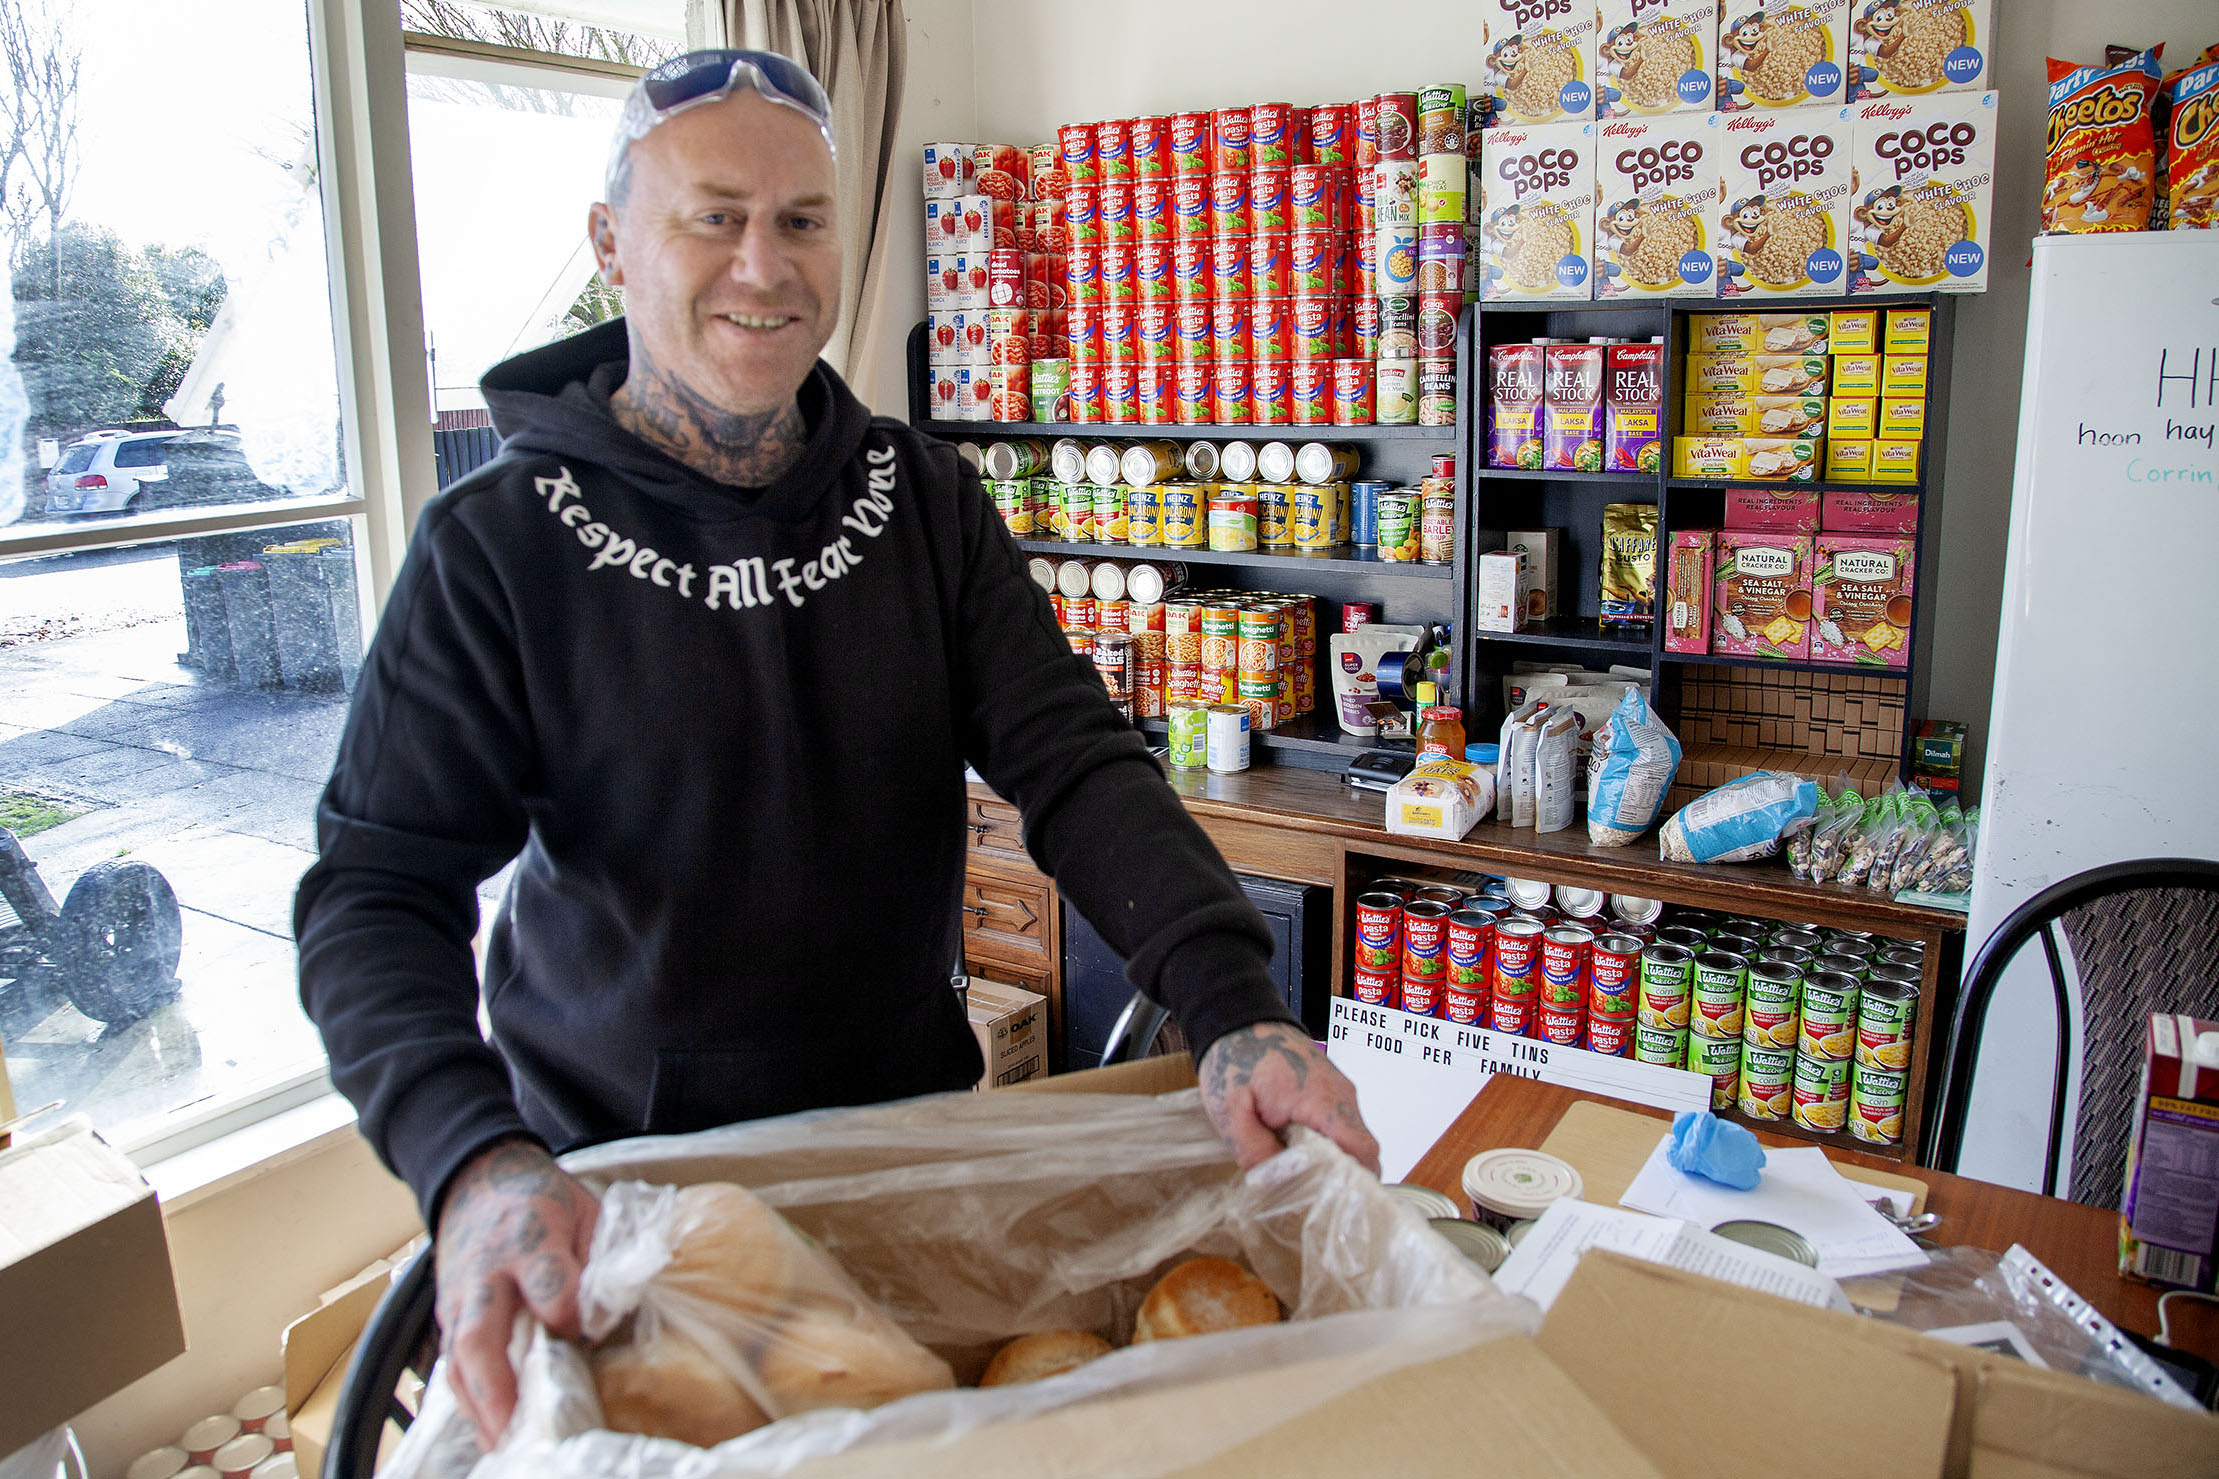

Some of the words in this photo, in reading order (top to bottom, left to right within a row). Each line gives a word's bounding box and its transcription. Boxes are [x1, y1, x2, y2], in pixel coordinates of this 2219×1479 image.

[1776, 9, 1811, 27] WHITE
[1811, 0, 1845, 14] CHOC
[1648, 20, 1681, 37] WHITE
[1682, 6, 1713, 24] CHOC
[1531, 32, 1563, 49] WHITE
[1562, 20, 1593, 37] CHOC
[1666, 24, 1702, 43] FLAVOUR
[1947, 59, 1980, 71] NEW
[1808, 73, 1838, 85] NEW
[1680, 80, 1708, 92] NEW
[1422, 91, 1450, 101] Wattie's
[1562, 92, 1589, 103] NEW
[1860, 103, 1912, 120] Kellogg's
[1253, 119, 1277, 132] pasta
[1727, 118, 1775, 134] Kellogg's
[2047, 86, 2144, 155] Cheetos
[1602, 123, 1649, 138] Kellogg's
[1487, 132, 1528, 147] Kellogg's
[1875, 122, 1976, 159] COCO
[1616, 140, 1703, 174] COCO
[1740, 134, 1834, 170] COCO
[1499, 148, 1579, 180] COCO
[1894, 148, 1965, 181] pops
[1632, 164, 1694, 194] pops
[1758, 159, 1824, 191] pops
[1514, 171, 1571, 200] pops
[1913, 184, 1952, 203] WHITE
[1954, 174, 1989, 192] CHOC
[1650, 198, 1683, 215] WHITE
[1685, 188, 1717, 204] CHOC
[1776, 194, 1812, 212] WHITE
[1814, 184, 1847, 202] CHOC
[1934, 192, 1976, 211] FLAVOUR
[1530, 204, 1561, 221] WHITE
[1562, 194, 1592, 210] CHOC
[1667, 204, 1705, 222] FLAVOUR
[1795, 201, 1835, 220] FLAVOUR
[1546, 211, 1580, 227] FLAVOUR
[1810, 260, 1840, 271] NEW
[1949, 253, 1981, 265] NEW
[1558, 265, 1585, 276] NEW
[1681, 261, 1710, 272] NEW
[1497, 350, 1534, 361] Campbell's
[1554, 349, 1593, 361] Campbell's
[1616, 349, 1655, 361] Campbell's
[1336, 377, 1359, 388] pasta
[1497, 371, 1535, 388] REAL
[1554, 371, 1593, 388] REAL
[1616, 371, 1658, 388] REAL
[1496, 388, 1535, 400] STOCK
[1553, 388, 1593, 401] STOCK
[1615, 388, 1658, 401] STOCK
[1503, 417, 1527, 425] LAKSA
[1560, 418, 1585, 426] LAKSA
[2078, 422, 2142, 446] hoon
[2166, 418, 2215, 449] hay
[1129, 493, 1152, 502] HEINZ
[1166, 494, 1190, 503] HEINZ
[1259, 493, 1282, 502] HEINZ
[1425, 500, 1454, 509] Wattie's
[534, 465, 697, 598] Respect
[704, 556, 775, 610] All
[771, 534, 864, 608] Fear
[842, 444, 896, 538] None
[1423, 526, 1454, 534] BARLEY
[1610, 536, 1656, 553] L'AFFARE
[1617, 554, 1650, 562] GUSTO
[1741, 555, 1788, 564] NATURAL
[1840, 558, 1889, 568] NATURAL
[1839, 566, 1873, 574] CRACKER
[1742, 579, 1760, 588] SEA
[1761, 580, 1783, 589] SALT
[1841, 584, 1859, 593] SEA
[1861, 585, 1883, 593] SALT
[1745, 587, 1786, 596] VINEGAR
[1844, 592, 1887, 601] VINEGAR
[1202, 622, 1234, 631] Spaghetti
[1241, 625, 1274, 634] Spaghetti
[1425, 744, 1448, 753] Craig's
[1925, 749, 1951, 759] Dilmah
[1361, 910, 1390, 924] Wattie's
[1363, 924, 1389, 935] pasta
[1408, 919, 1439, 932] Wattie's
[1411, 932, 1437, 943] pasta
[1450, 928, 1477, 940] Wattie's
[1450, 941, 1476, 952] pasta
[1499, 937, 1529, 951] Wattie's
[1500, 952, 1527, 963] pasta
[1544, 946, 1573, 960] Wattie's
[1545, 959, 1571, 970] pasta
[1594, 953, 1626, 968] Wattie's
[1596, 968, 1623, 979] pasta
[1650, 965, 1683, 978] Wattie's
[1702, 972, 1738, 987] Wattie's
[1754, 982, 1790, 997] Wattie's
[1708, 995, 1727, 1004] corn
[1807, 990, 1842, 1006] Wattie's
[1760, 1005, 1779, 1013] corn
[1862, 998, 1897, 1015] Wattie's
[1010, 1013, 1037, 1033] OAK
[1812, 1014, 1830, 1024] corn
[1334, 1003, 1387, 1028] PLEASE
[1404, 1019, 1440, 1040] PICK
[1458, 1031, 1490, 1051] FIVE
[1512, 1042, 1549, 1064] TINS
[1866, 1024, 1884, 1033] corn
[1001, 1045, 1019, 1059] SLICED
[1019, 1035, 1036, 1050] APPLES
[1332, 1024, 1349, 1042] OF
[1367, 1032, 1402, 1054] FOOD
[1423, 1046, 1451, 1066] PER
[1481, 1059, 1540, 1080] FAMILY
[1752, 1053, 1788, 1068] Wattie's
